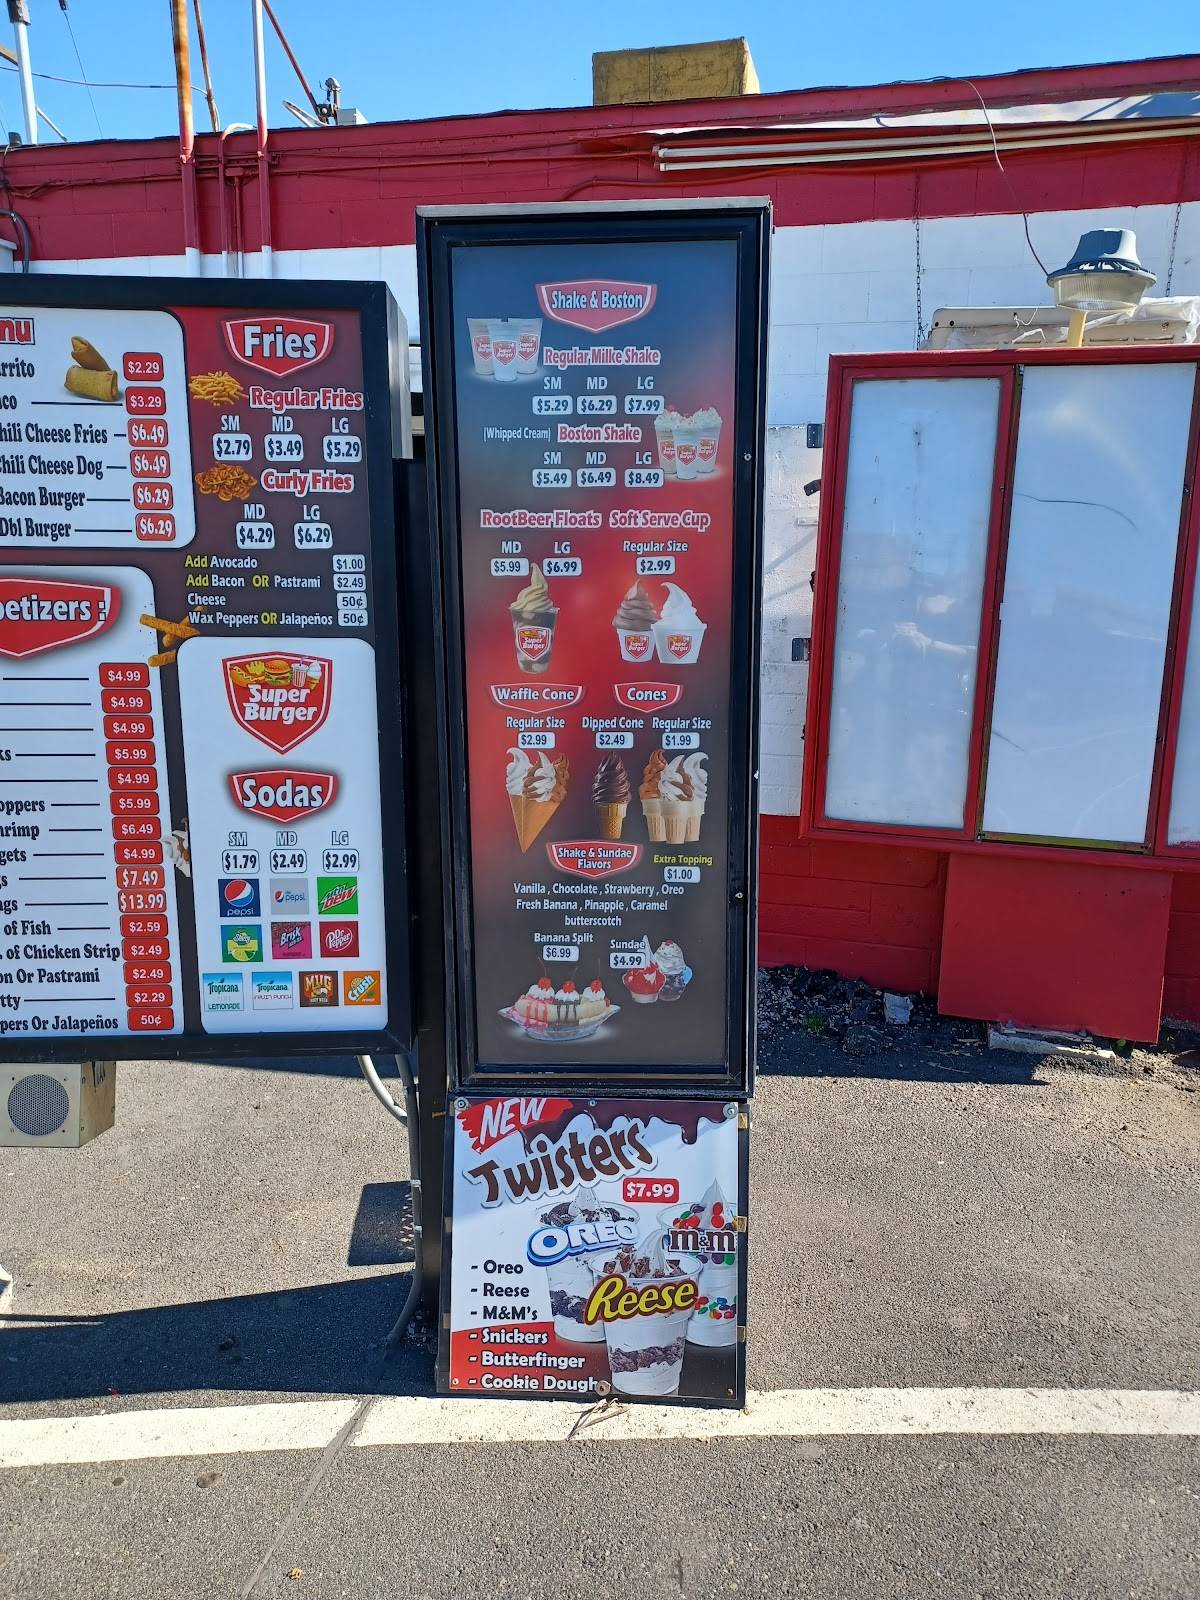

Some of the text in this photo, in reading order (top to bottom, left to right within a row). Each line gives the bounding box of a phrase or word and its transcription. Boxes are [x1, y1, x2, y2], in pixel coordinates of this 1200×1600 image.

[552, 290, 643, 309] Shake Boston
[244, 325, 317, 359] Fries
[544, 347, 660, 369] Regular Milke Shake
[128, 361, 160, 375] $2.29
[543, 377, 654, 390] SM MD LG
[130, 395, 162, 409] $3.29
[250, 386, 363, 413] Regular Fries
[537, 398, 660, 412] $5.29 $6.29 $7.99
[220, 415, 349, 433] SM MD LG
[25, 422, 108, 443] Cheese Fries
[131, 424, 165, 444] $6.49
[484, 424, 641, 442] (Whipped Cream) Boston Shake
[216, 437, 360, 460] $2.79 $3.49 $5.29
[134, 455, 168, 475] $6.49
[543, 452, 652, 465] SM MD LG
[28, 454, 103, 480] Cheese Dog
[261, 469, 354, 496] Curly Fries
[536, 471, 660, 486] $5.49 $6.49 $8.49
[38, 486, 85, 511] Burger
[137, 486, 170, 507] $6.29
[244, 504, 321, 521] MD LG
[481, 509, 602, 528] RootBeer Floats
[609, 508, 710, 531] Soft Serve Cup
[0, 517, 71, 542] Dbl Burger
[139, 518, 173, 539] $6.29
[239, 526, 331, 545] $4.29 $6.29
[501, 541, 571, 553] MD LG
[623, 540, 688, 554] Regular Size
[185, 555, 258, 569] Add Avocado
[336, 558, 363, 570] $1.00
[494, 559, 671, 574] $5.99 $6.99 $2.99
[186, 574, 321, 588] Add Bacon OR Pastrami
[337, 577, 364, 589] $2.49
[187, 592, 226, 606] Cheese
[342, 596, 363, 608] 50¢
[188, 611, 333, 628] Wax Peppers OR Jalapeños
[248, 685, 311, 706] Super
[498, 687, 575, 701] Waffle Cone
[627, 687, 667, 701] Cones
[243, 703, 318, 725] Burger
[506, 716, 565, 730] Regular Size
[582, 717, 644, 731] Dipped Cone
[652, 717, 712, 731] Regular Size
[521, 734, 547, 746] $2.99
[599, 734, 625, 746] $2.49
[665, 735, 691, 747] $1.99
[114, 748, 147, 760] $5.99
[242, 778, 323, 808] Sodas
[119, 798, 151, 810] $5.99
[121, 823, 154, 835] $6.49
[228, 831, 350, 847] SM MD LG
[558, 847, 632, 858] Shake Sundae
[225, 852, 357, 871] $1.79 $2.49 $2.99
[577, 859, 612, 869] Flavors
[653, 855, 713, 866] Extra Topping
[122, 870, 159, 888] $7.49
[667, 868, 693, 880] $1.00
[513, 883, 685, 897] Vanilla Chocolate Strawberry Oreo
[119, 893, 165, 911] $13.99
[516, 899, 541, 910] Fresh
[543, 899, 578, 911] Banana
[630, 900, 668, 911] Caramel
[227, 908, 254, 917] pepsi
[4, 920, 51, 935] of Fish
[564, 916, 622, 926] butterscotch
[534, 933, 594, 944] Banana Split
[610, 940, 645, 949] Sundae
[6, 943, 120, 961] of Chicken Strip
[545, 947, 571, 959] $6.99
[613, 955, 642, 966] $4.99
[16, 968, 100, 983] Or Pastrami
[305, 975, 333, 991] MUG
[208, 982, 239, 994] Tropicana
[257, 982, 288, 993] Tropicana
[134, 991, 166, 1003] $2.29
[31, 1015, 118, 1032] Or Jalapeños
[479, 1098, 548, 1145] NEW
[468, 1122, 653, 1203] Twisters
[626, 1181, 675, 1198] $7.99
[529, 1219, 640, 1258] OREO
[483, 1259, 524, 1274] Oreo
[483, 1282, 530, 1297] Reese
[585, 1274, 697, 1324] Reese
[483, 1305, 538, 1321] M&M's
[481, 1328, 548, 1344] Snickers
[480, 1352, 586, 1370] Butterfinger
[480, 1373, 599, 1393] Cookie Dough
